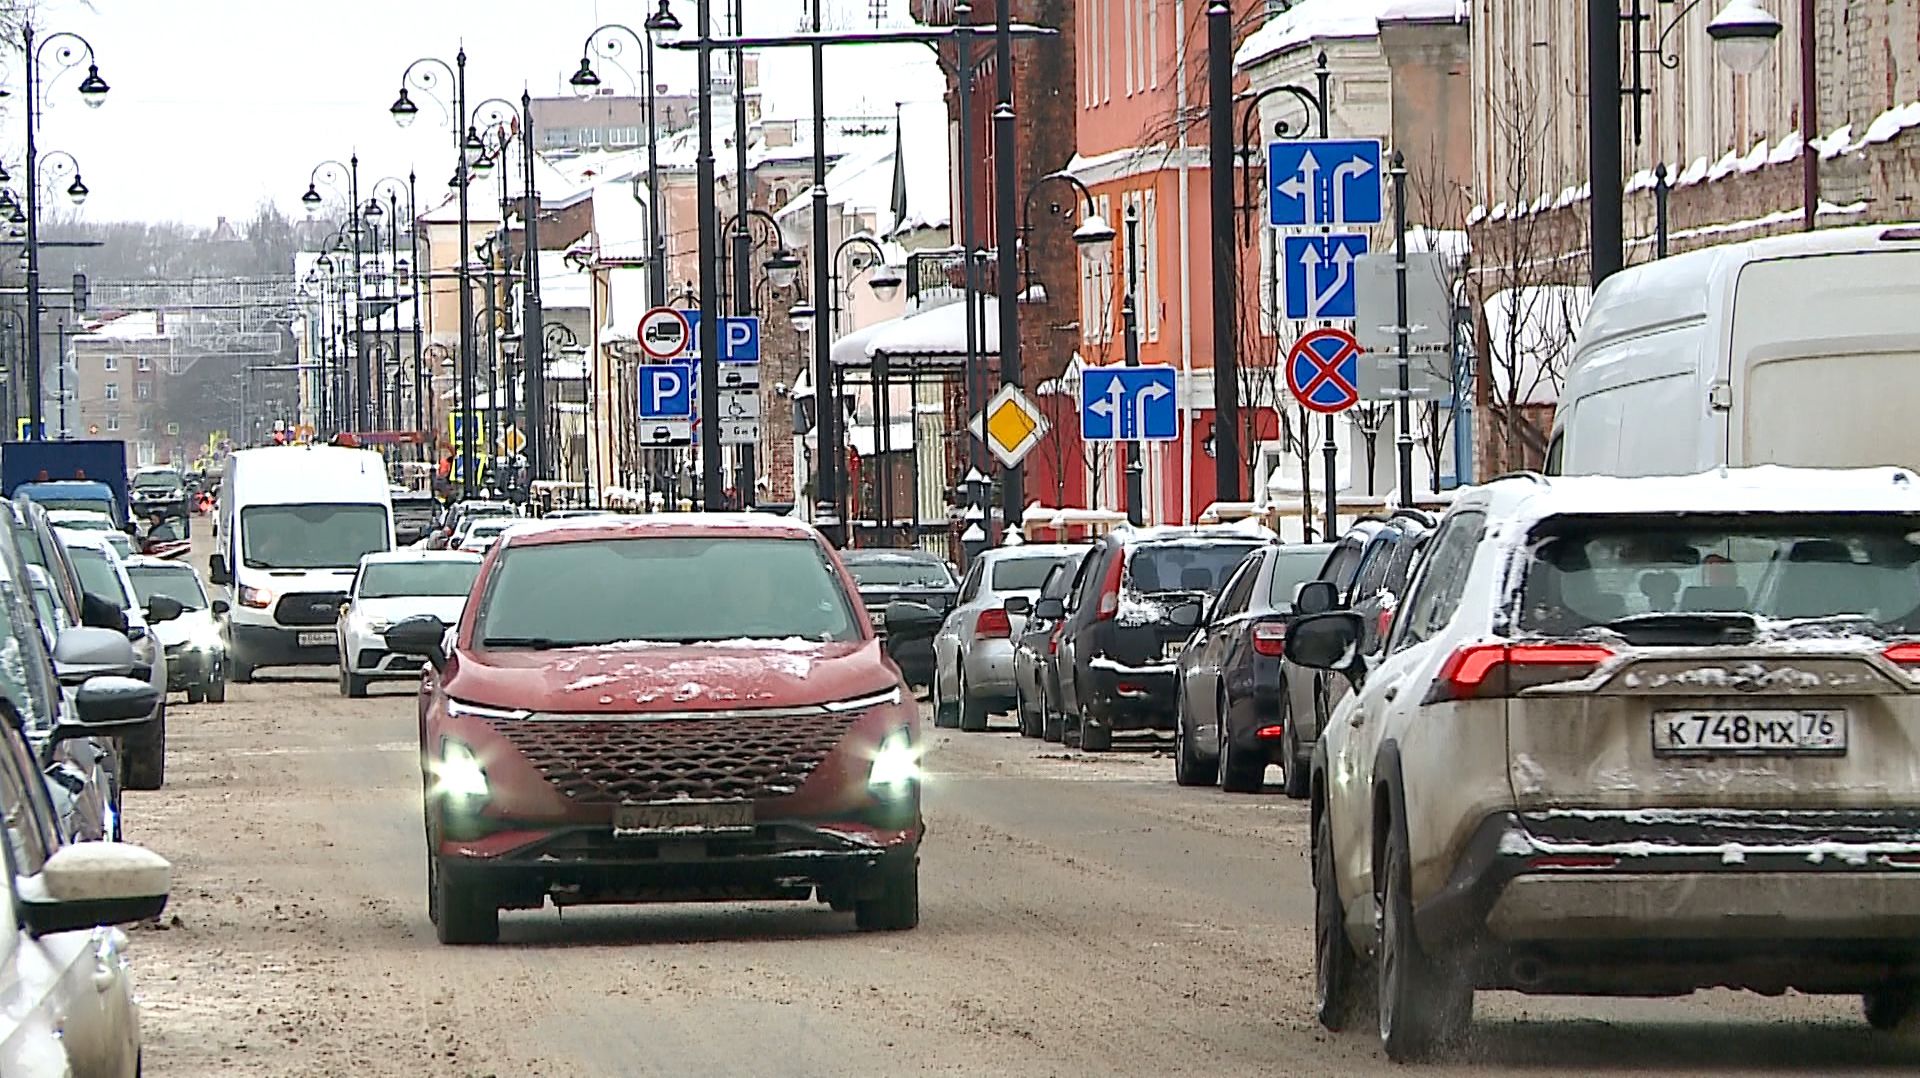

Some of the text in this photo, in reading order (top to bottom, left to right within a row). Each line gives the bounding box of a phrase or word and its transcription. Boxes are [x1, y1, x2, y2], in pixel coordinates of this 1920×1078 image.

[726, 322, 751, 358] P
[653, 371, 681, 412] P
[1668, 714, 1833, 745] К748МХ 76
